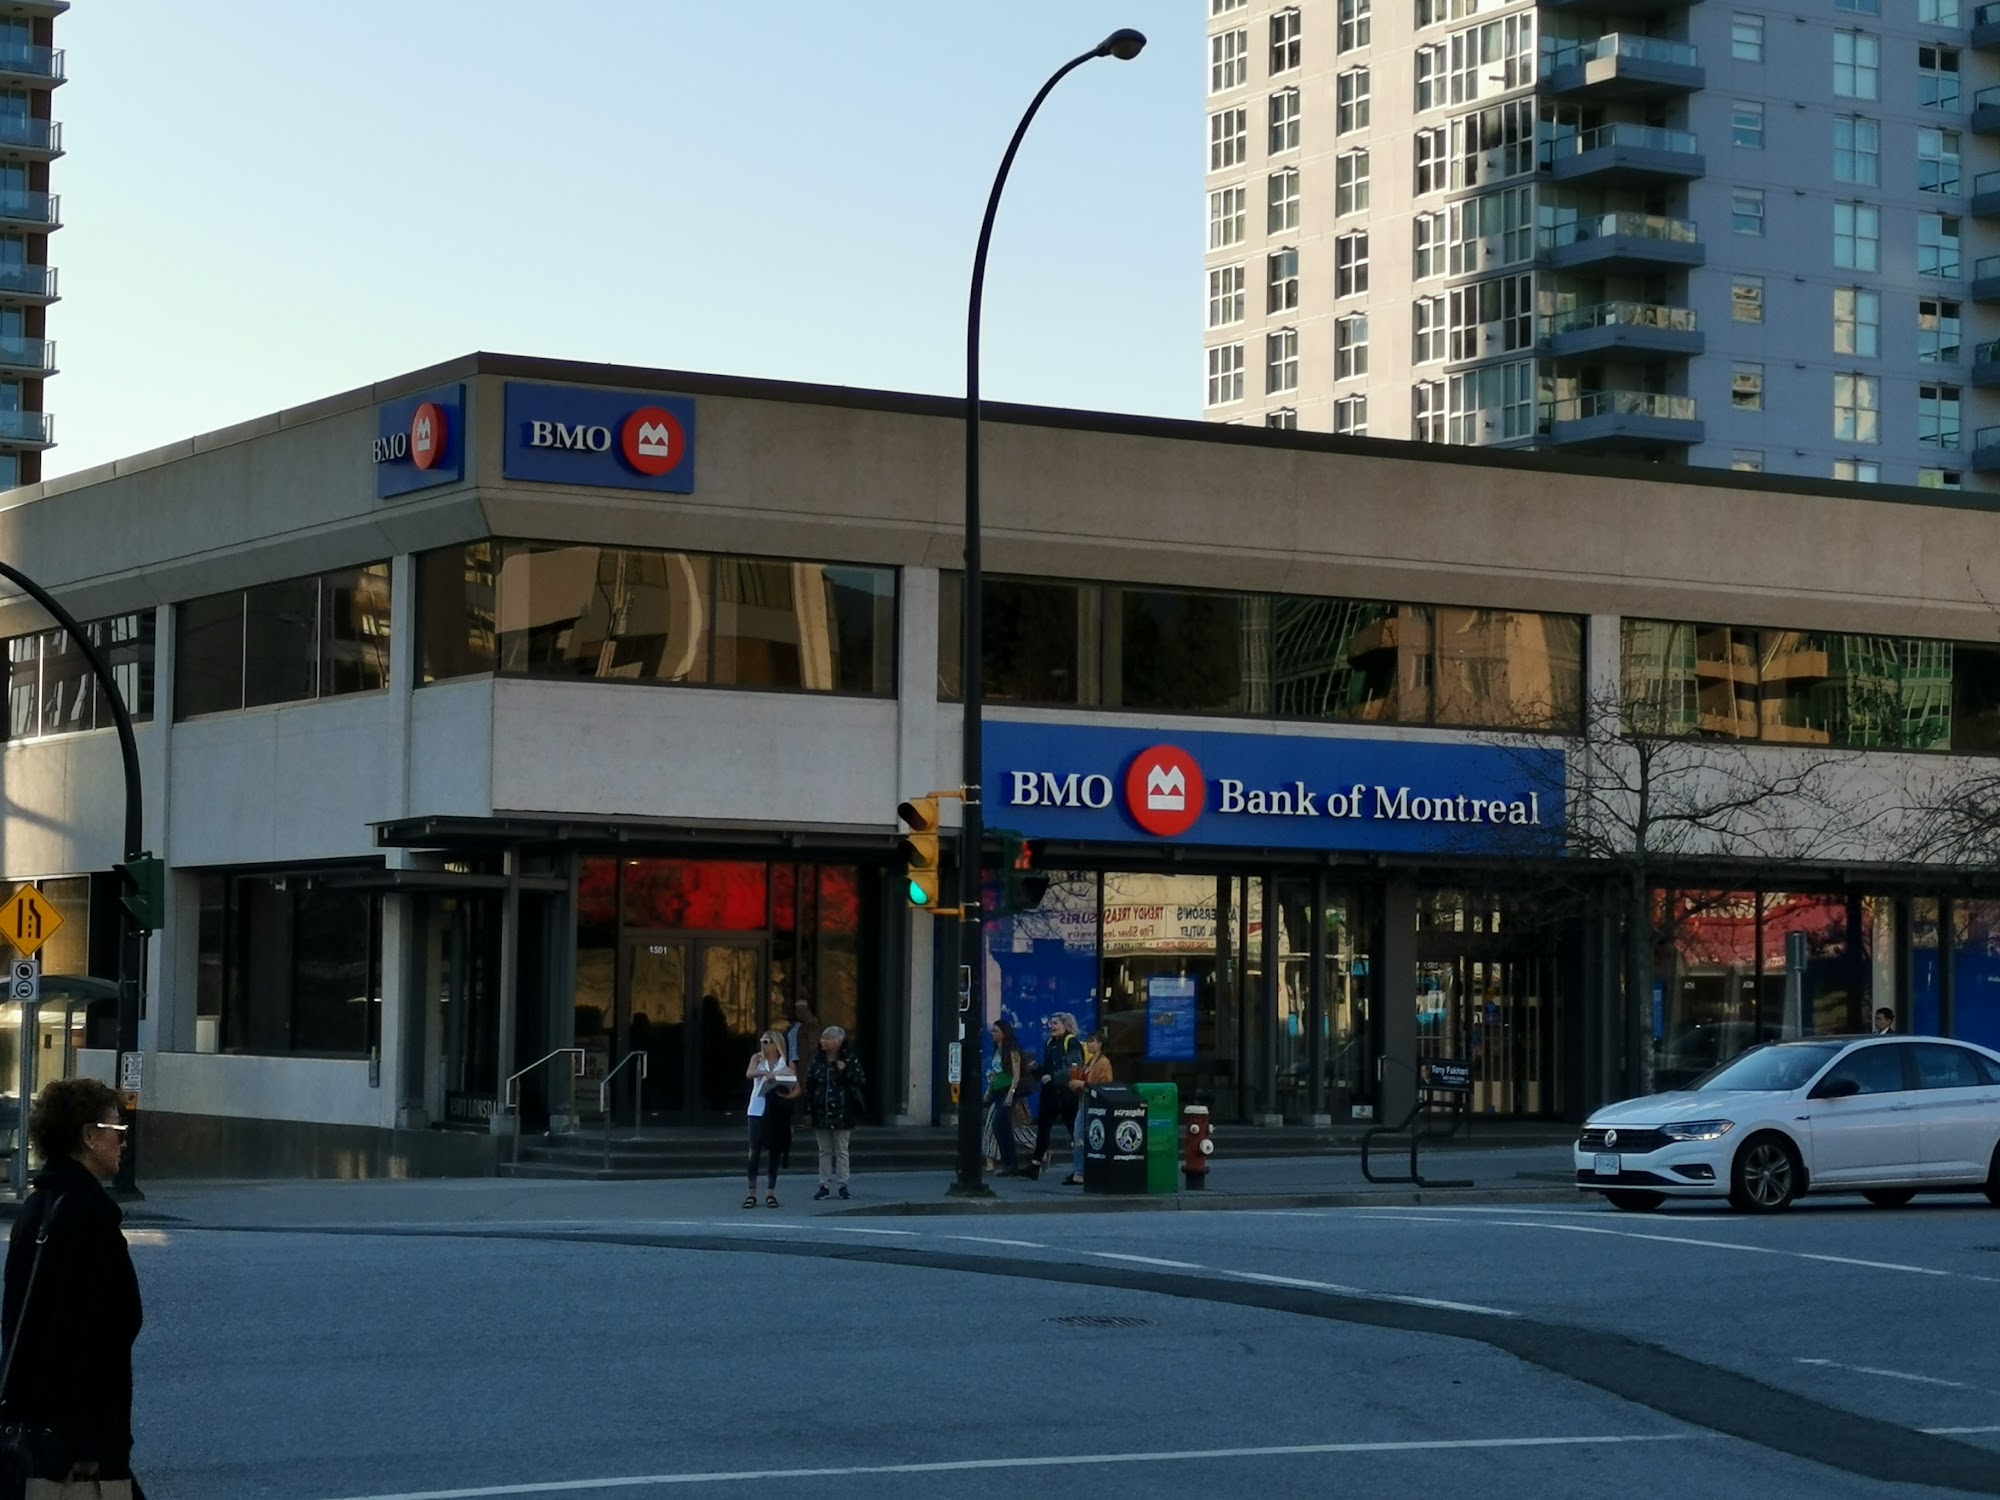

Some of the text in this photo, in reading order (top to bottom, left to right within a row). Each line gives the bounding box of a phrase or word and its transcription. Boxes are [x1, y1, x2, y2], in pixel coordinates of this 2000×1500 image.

[371, 432, 407, 464] BMO
[530, 420, 612, 452] BMO
[1010, 770, 1113, 809] BMO
[1219, 778, 1540, 826] Bank of Montreal
[648, 945, 667, 955] 1501
[468, 1098, 497, 1119] LONSDA
